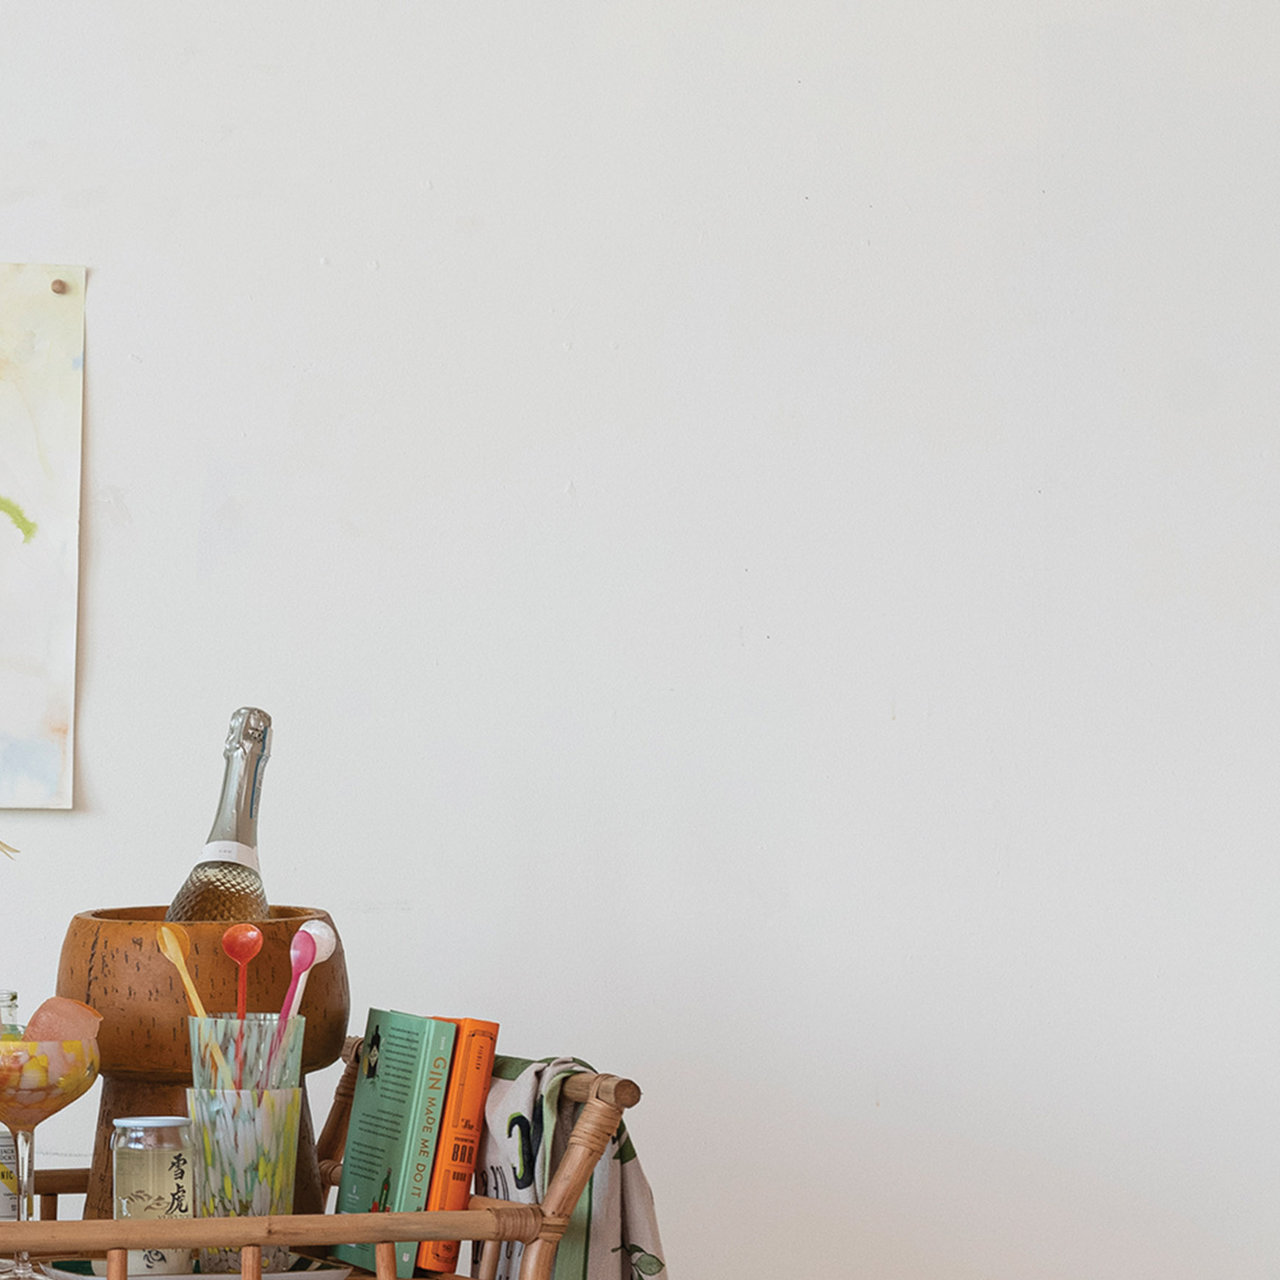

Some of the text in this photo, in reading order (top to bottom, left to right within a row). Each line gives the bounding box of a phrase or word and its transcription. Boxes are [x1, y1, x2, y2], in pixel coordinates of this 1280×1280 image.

[428, 1057, 447, 1090] GIN
[422, 1096, 436, 1134] MADE
[418, 1138, 429, 1157] ME
[451, 1143, 475, 1164] BAR
[165, 1152, 189, 1215] 雪虎
[413, 1163, 426, 1183] DO
[411, 1186, 422, 1199] IT
